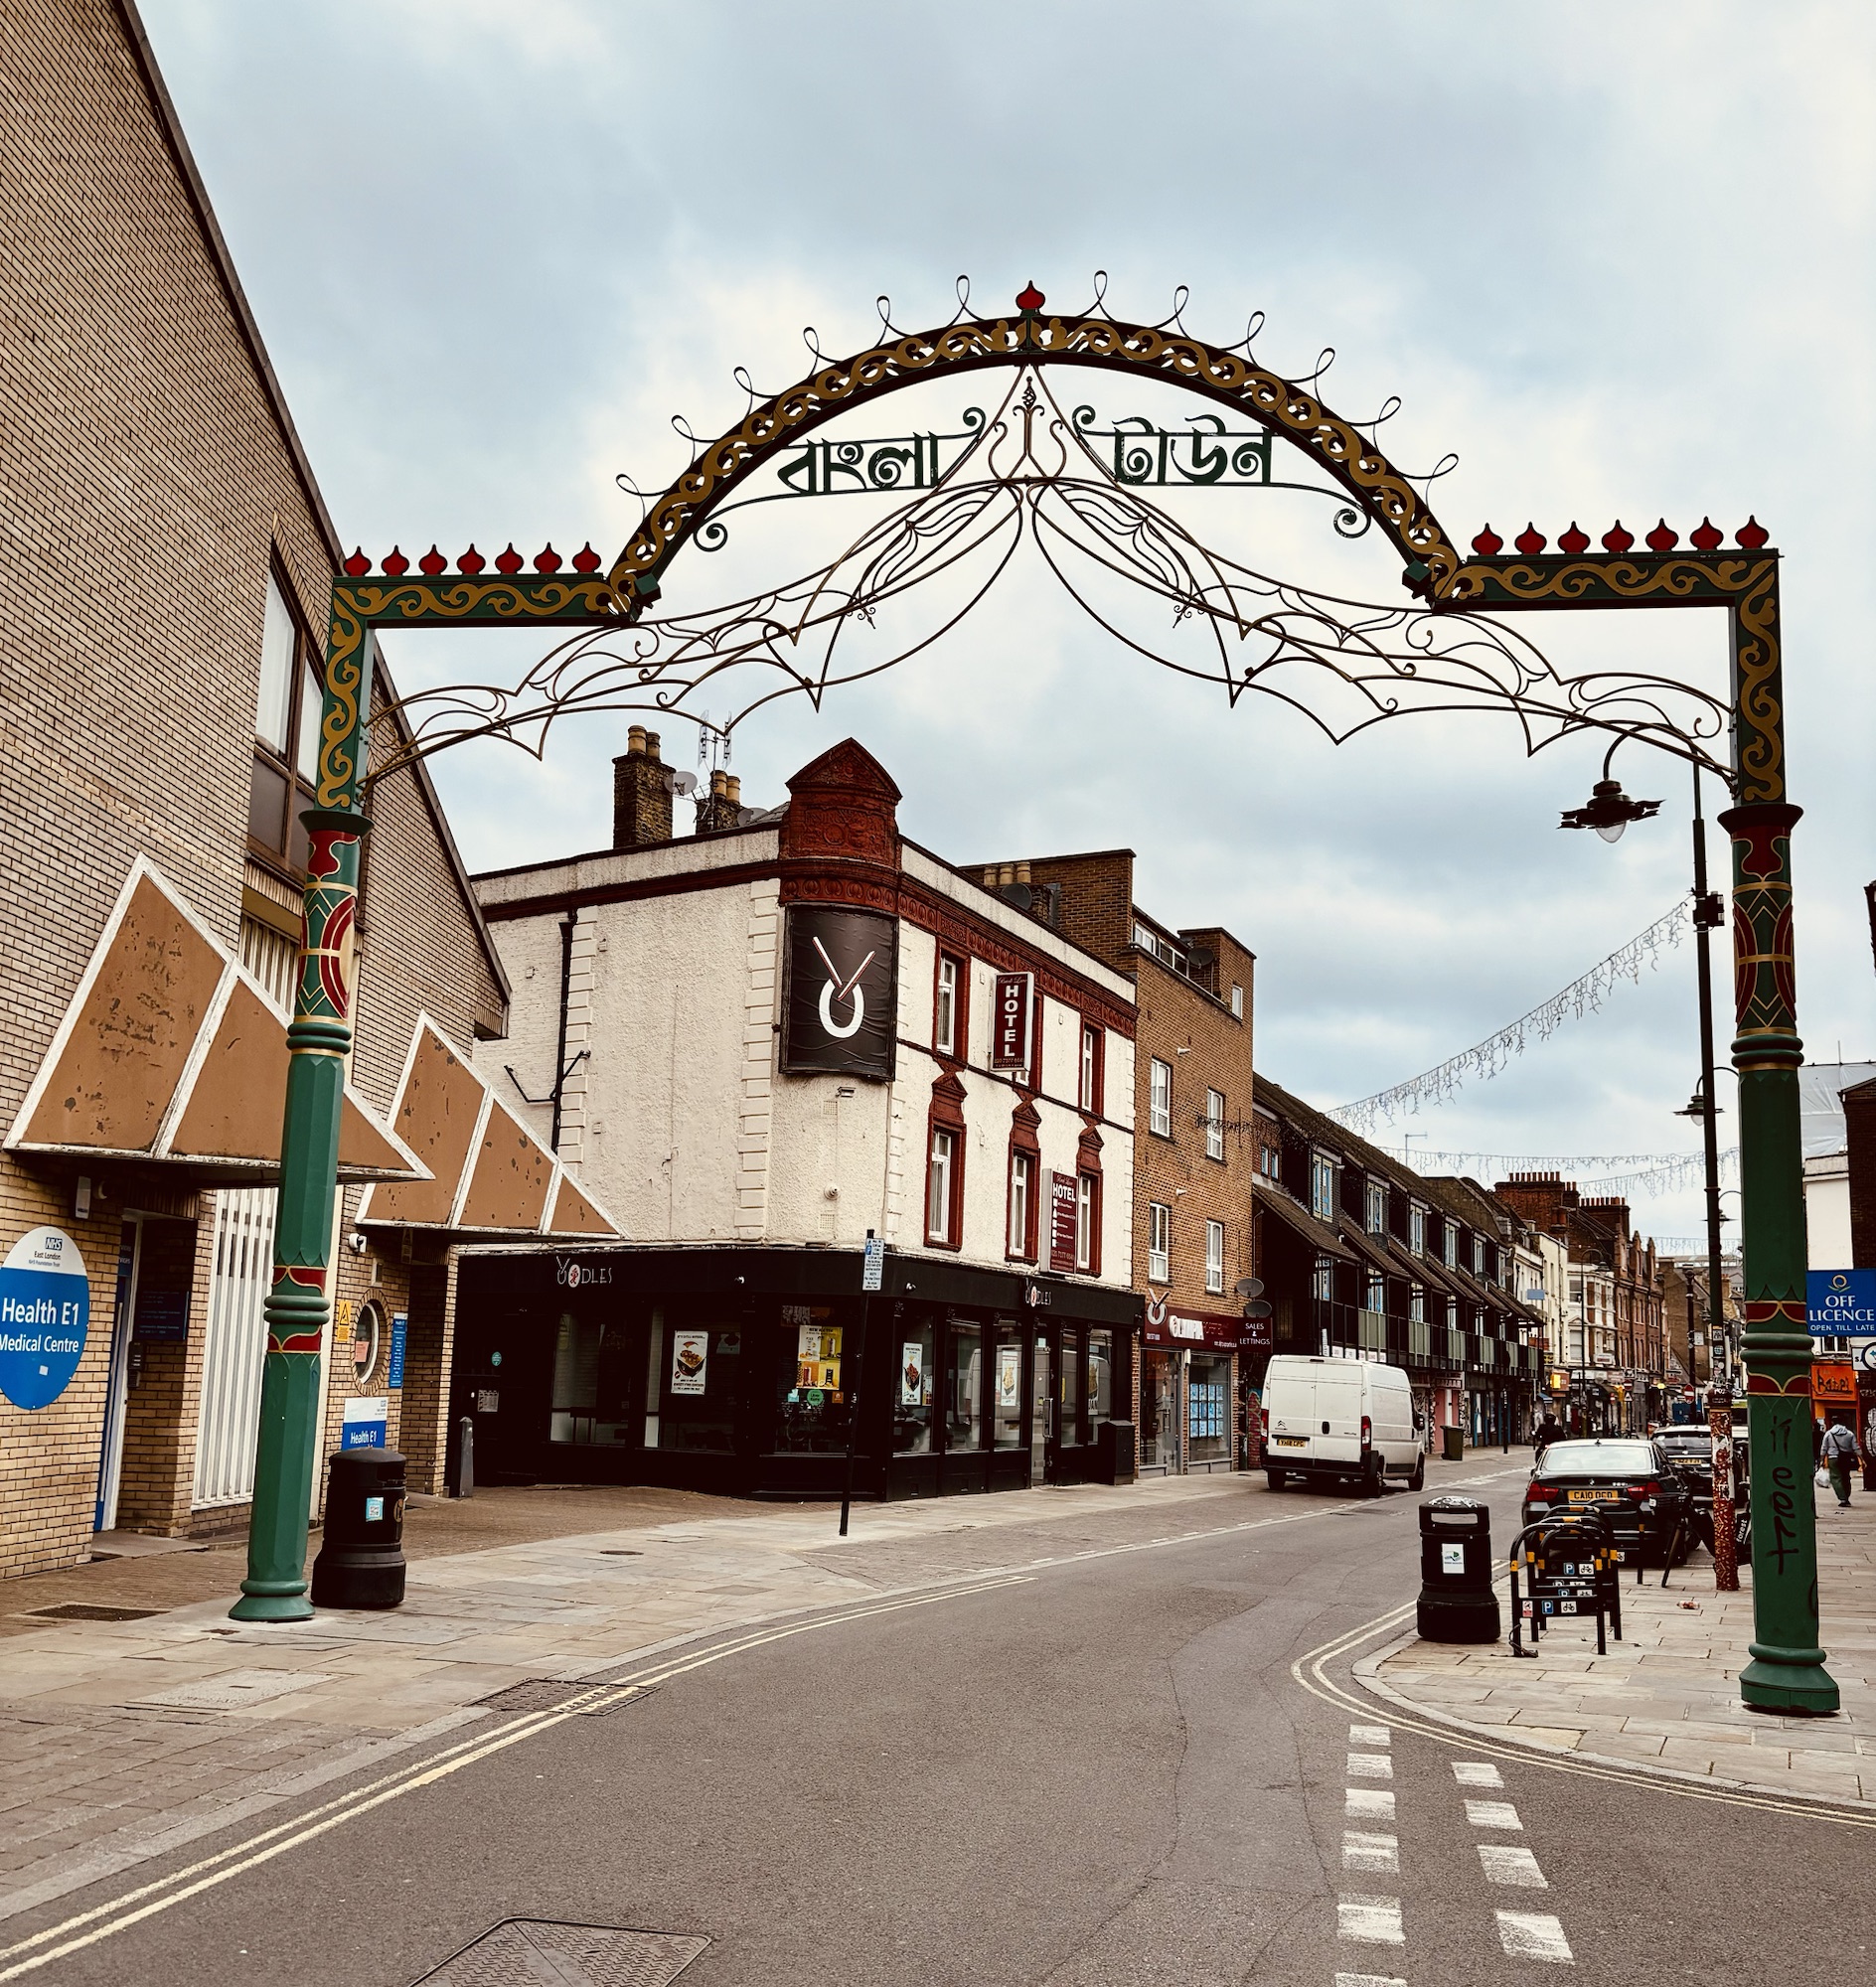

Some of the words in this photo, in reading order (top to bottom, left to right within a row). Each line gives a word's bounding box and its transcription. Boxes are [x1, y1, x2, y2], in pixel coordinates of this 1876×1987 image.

[777, 431, 938, 495] বাংলা
[1112, 414, 1273, 485] টাউন
[1004, 985, 1019, 1057] HOTEL
[1052, 1183, 1076, 1201] HOTEL
[46, 1237, 63, 1250] NHS
[1825, 1295, 1856, 1307] OFF
[2, 1298, 57, 1324] Health
[62, 1301, 79, 1325] E1
[1809, 1309, 1875, 1321] LICENCE
[0, 1333, 42, 1352] Medical
[44, 1335, 79, 1353] Centre
[350, 1431, 369, 1444] Health
[370, 1431, 377, 1443] E1
[1736, 1519, 1748, 1543] forest
